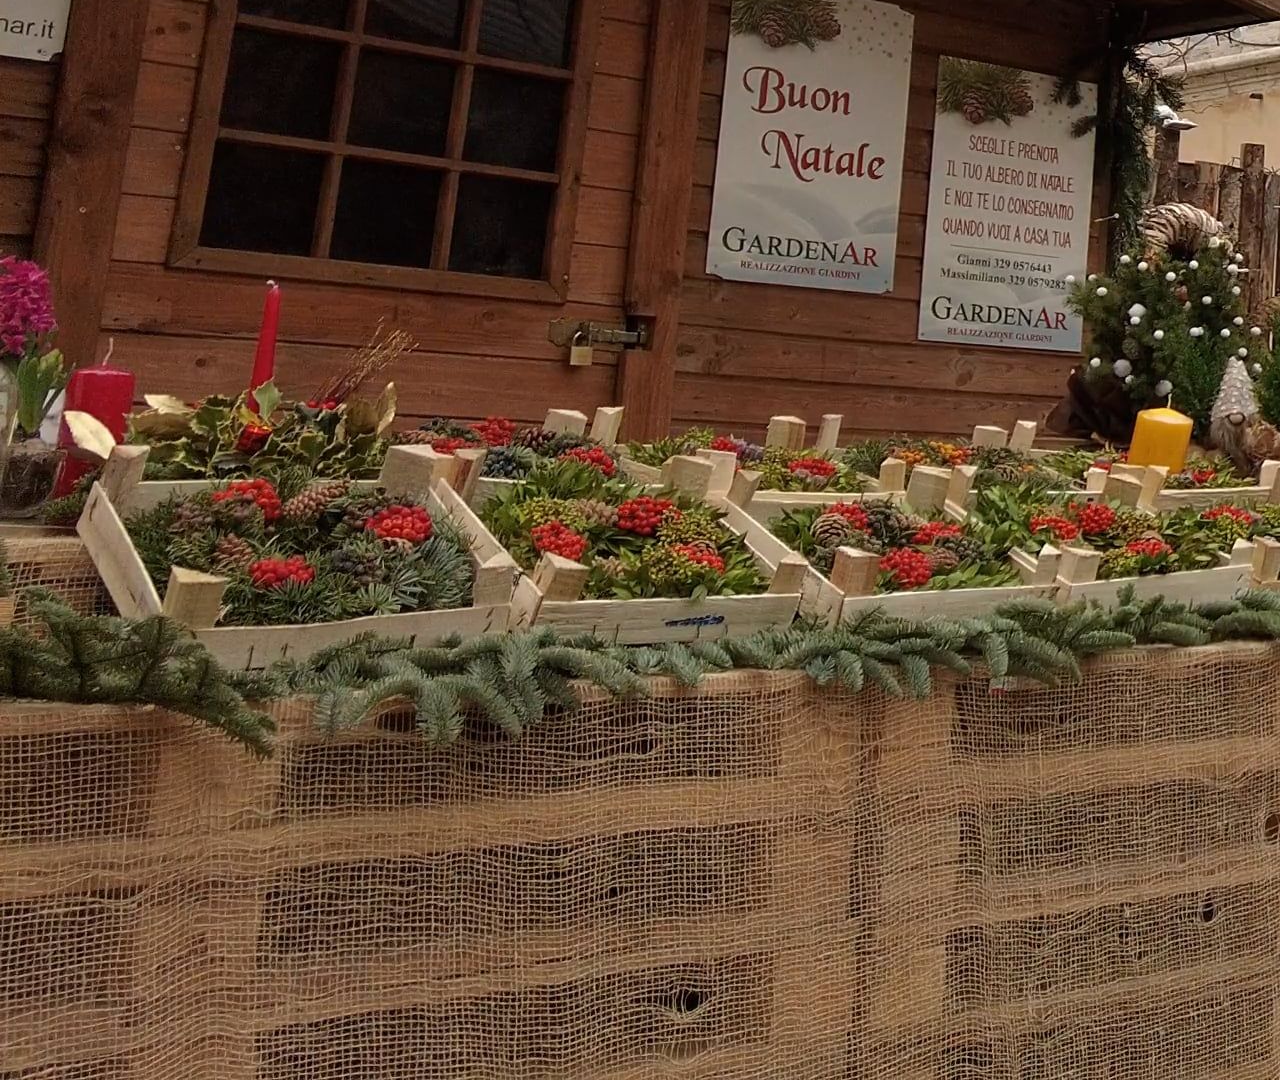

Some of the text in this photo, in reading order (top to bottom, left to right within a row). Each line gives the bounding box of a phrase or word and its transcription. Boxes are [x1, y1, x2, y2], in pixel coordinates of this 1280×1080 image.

[743, 66, 851, 116] Buon
[761, 129, 885, 183] Natale
[968, 134, 1059, 164] SCEGLI E PRENOTA
[946, 160, 1075, 193] IL TUO ALBERO DI NATALE
[944, 187, 1074, 221] E NOI TE LO CONSEGNAMO
[943, 217, 1072, 248] QUANDO VUOI A CASA TUA
[740, 260, 861, 281] REALIZZAZIONE GIARDINI
[957, 254, 1052, 273] Gianni 329 0576443
[940, 268, 1066, 290] Massimiliano 329 0579282
[947, 327, 1053, 342] REALIZZAZIONE GIARDINI
